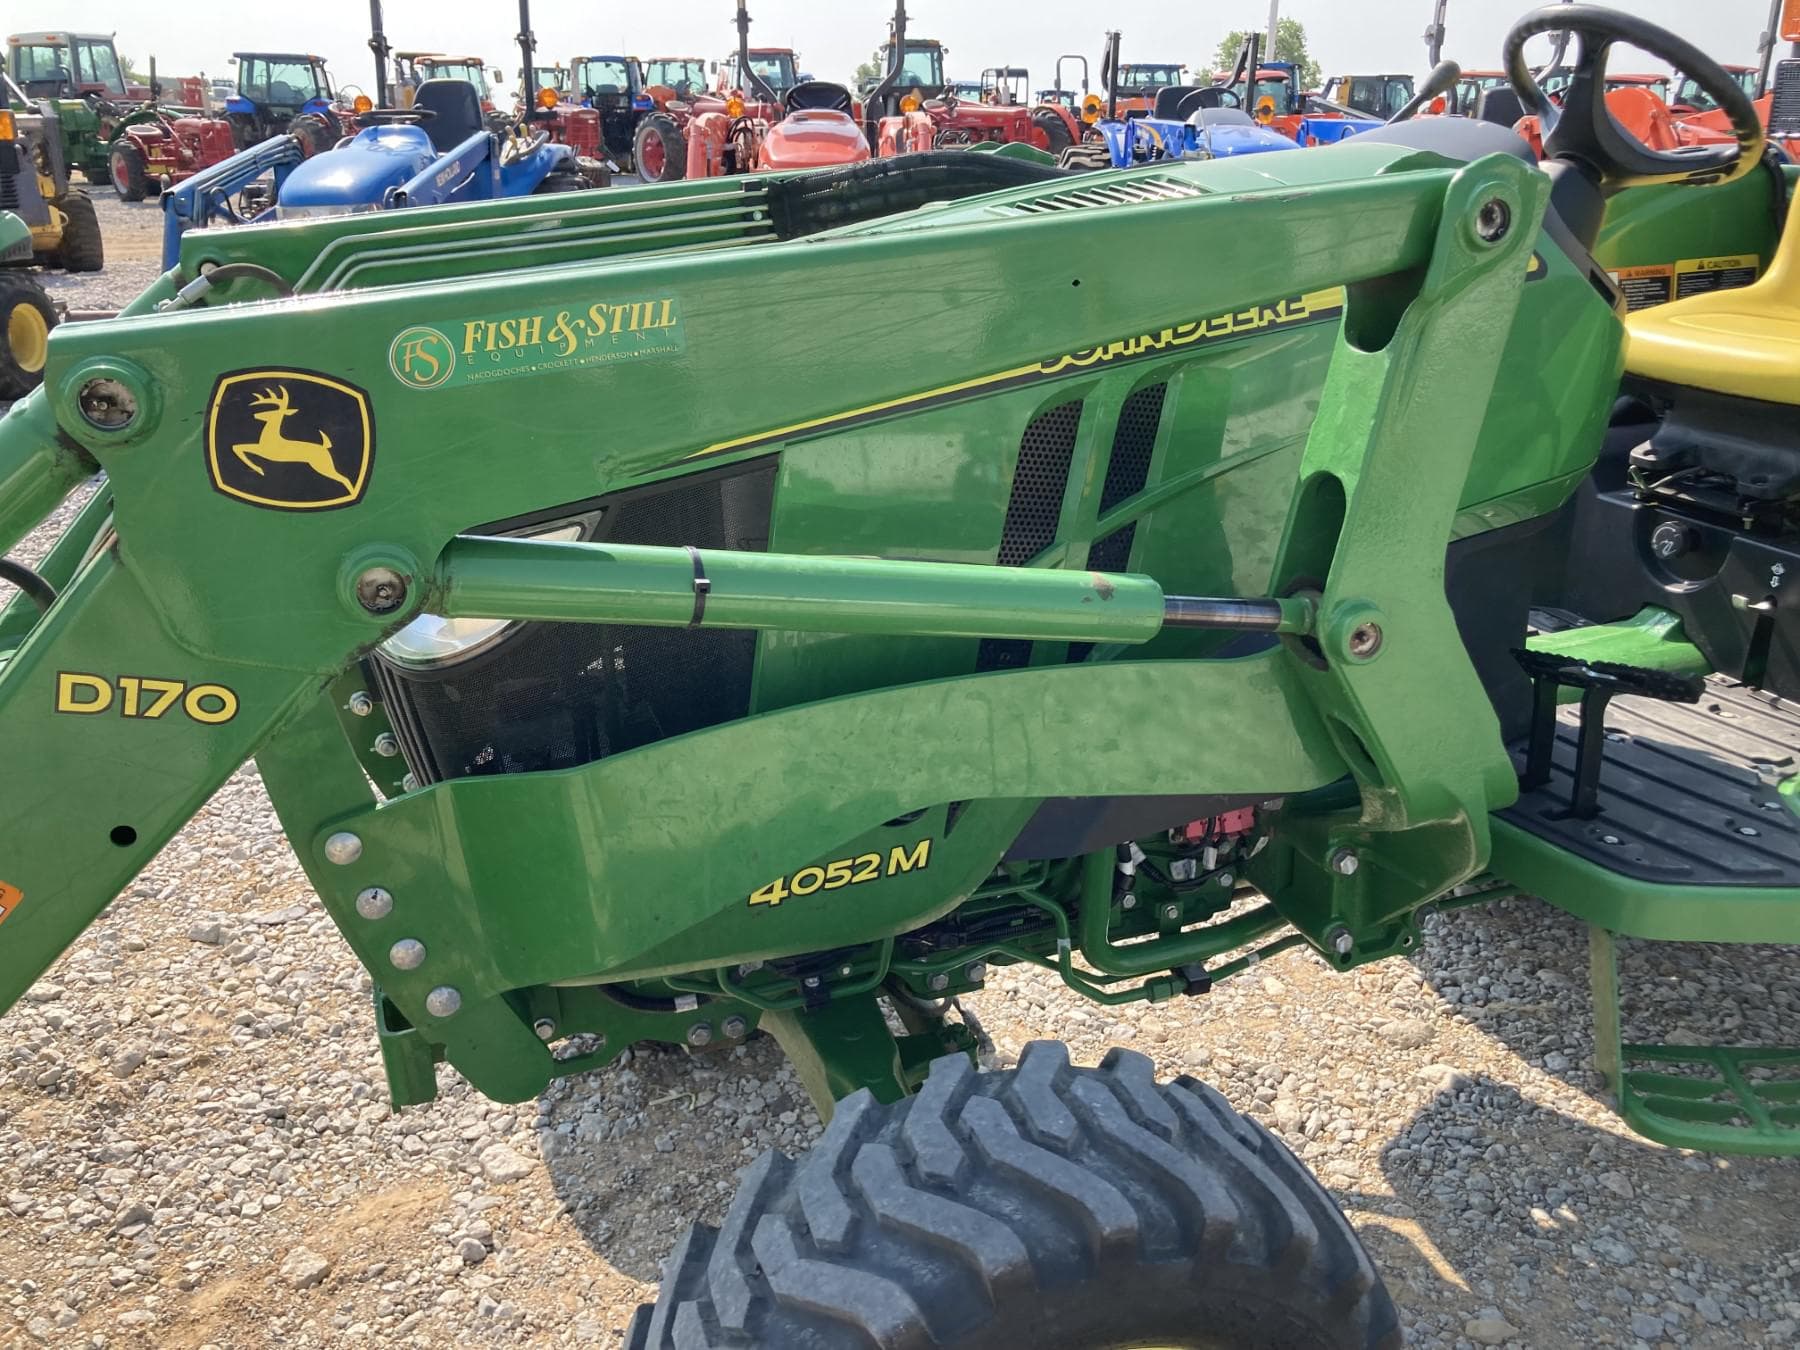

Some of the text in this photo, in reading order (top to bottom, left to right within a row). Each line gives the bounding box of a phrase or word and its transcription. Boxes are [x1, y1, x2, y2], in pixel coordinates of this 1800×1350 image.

[461, 299, 676, 357] FISH & STILL
[56, 671, 240, 725] D170
